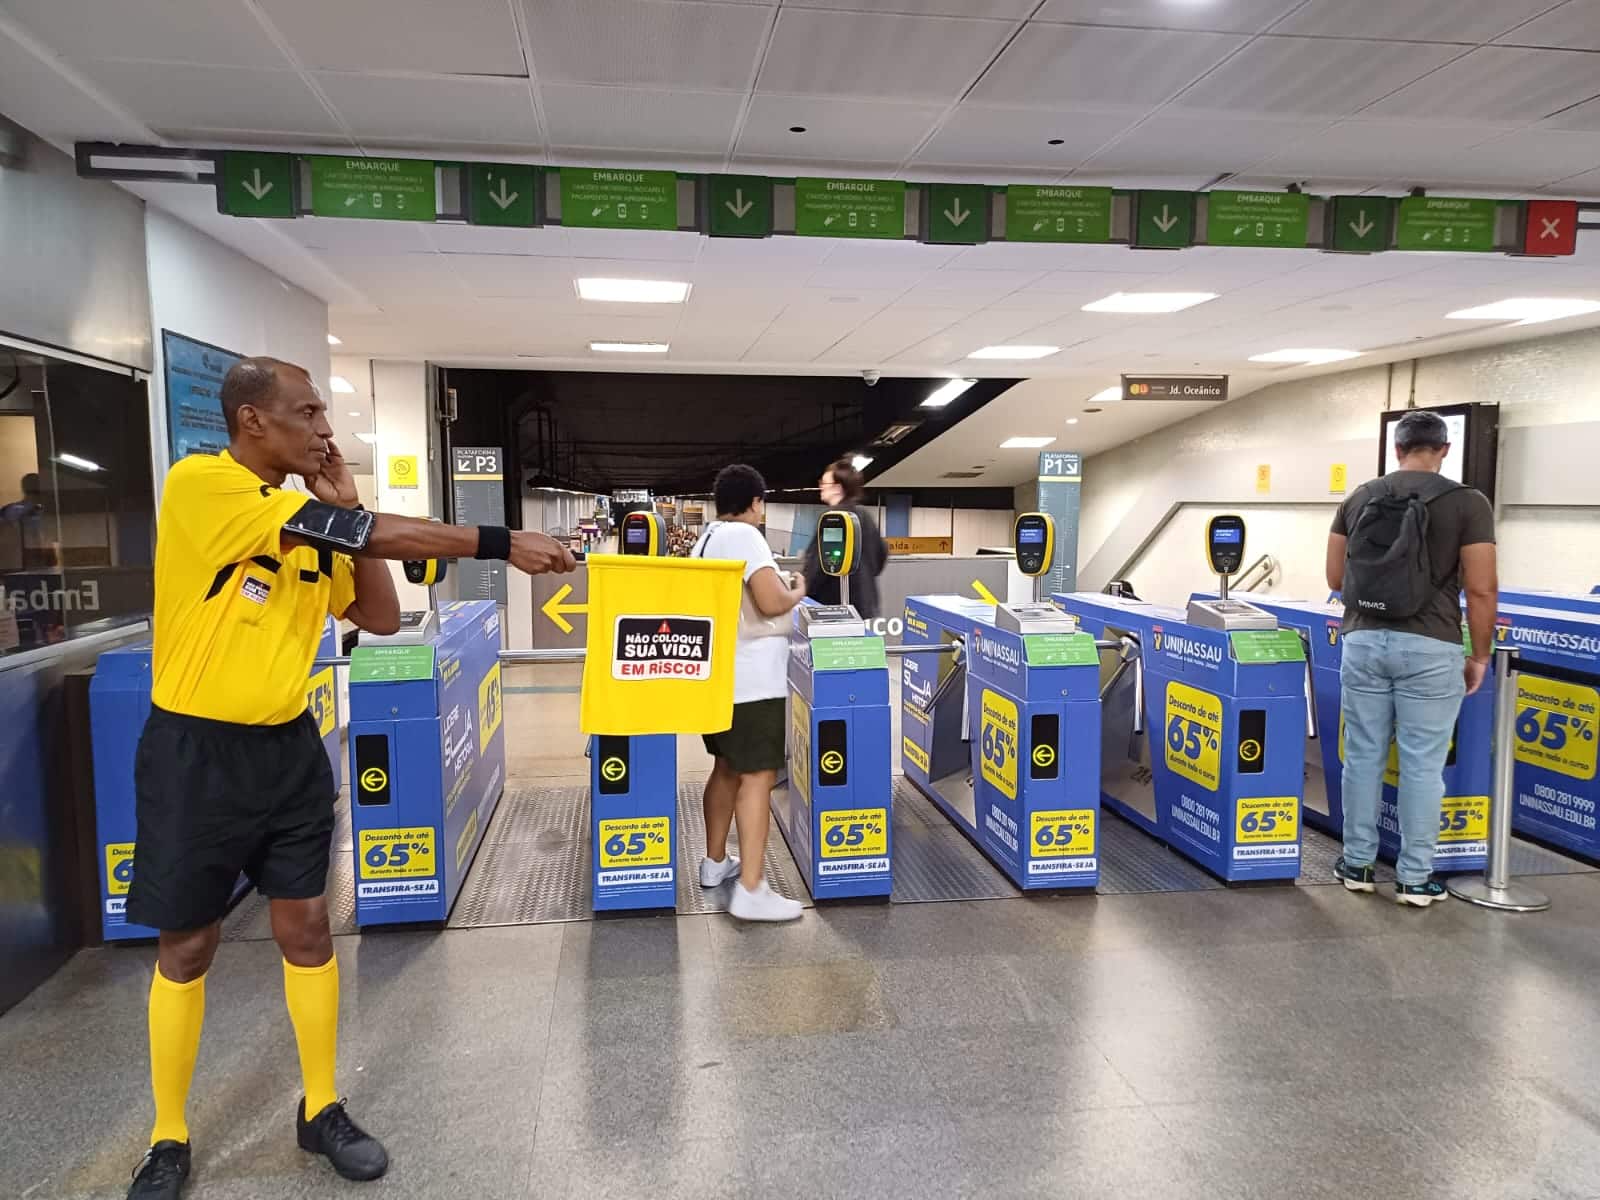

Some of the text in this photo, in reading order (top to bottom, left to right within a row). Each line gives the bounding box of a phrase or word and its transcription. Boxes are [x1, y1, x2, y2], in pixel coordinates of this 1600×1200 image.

[346, 160, 400, 172] EMBARQUE
[593, 171, 644, 182] EMBARQUE
[826, 181, 875, 192] EMBARQUE
[1036, 189, 1082, 199] EMBARQUE
[1169, 385, 1221, 395] Jd. Oceânico
[476, 455, 497, 472] P3
[1044, 458, 1064, 474] P1
[888, 541, 909, 551] aída
[625, 632, 704, 645] NÃO COLOQUE
[1512, 626, 1600, 653] UNINASSAU
[624, 644, 658, 658] SUA
[1164, 633, 1222, 663] UNINASSAU
[621, 663, 645, 675] EM
[1169, 695, 1196, 714] Desconto
[1197, 705, 1207, 718] de
[1518, 687, 1560, 706] Desconto
[1562, 698, 1575, 710] de
[1516, 707, 1593, 750] 65%
[983, 722, 1016, 768] 65%
[1168, 715, 1218, 760] 65%
[1534, 783, 1595, 813] 0800 281 9999
[1181, 794, 1196, 812] 0800
[1205, 807, 1219, 826] 9999
[1241, 810, 1293, 832] 65%
[365, 832, 402, 842] Desconto
[404, 832, 414, 840] de
[825, 822, 882, 847] 65%
[1035, 824, 1090, 846] 65%
[604, 832, 664, 857] 65%
[365, 842, 430, 867] 65%
[112, 858, 136, 882] 6
[822, 862, 878, 872] TRANSFIRA-SE
[1032, 862, 1084, 871] TRANSFIRA-SE
[602, 872, 659, 882] TRANSFIRA-SE
[362, 884, 425, 894] TRANSFIRA-SE
